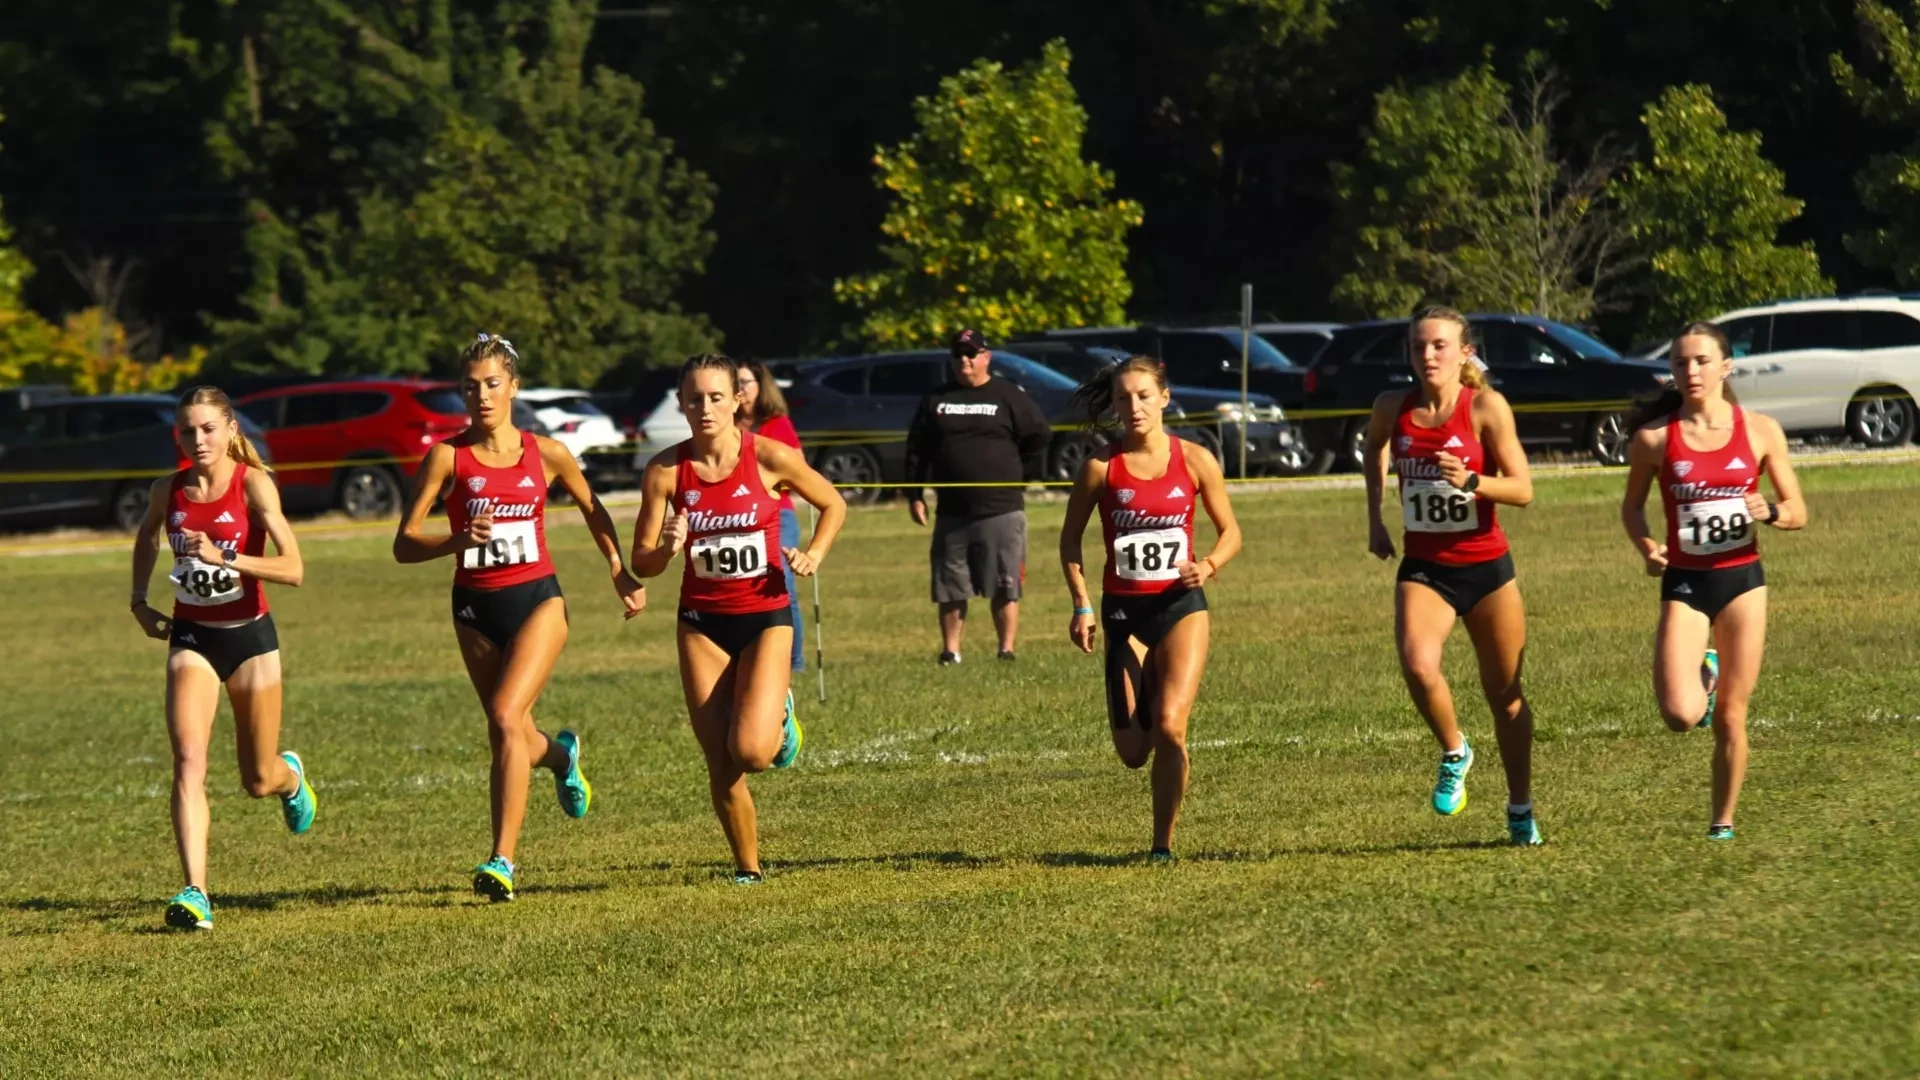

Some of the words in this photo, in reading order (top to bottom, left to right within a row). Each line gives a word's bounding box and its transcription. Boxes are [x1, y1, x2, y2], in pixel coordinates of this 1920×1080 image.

[1397, 456, 1471, 478] Mia
[687, 503, 758, 532] Miami
[1111, 504, 1190, 528] Miami
[1409, 493, 1469, 523] 186
[168, 531, 242, 555] Mmi
[1687, 512, 1749, 546] 189
[477, 535, 527, 567] 191
[698, 544, 759, 575] 190
[1122, 541, 1181, 571] 187
